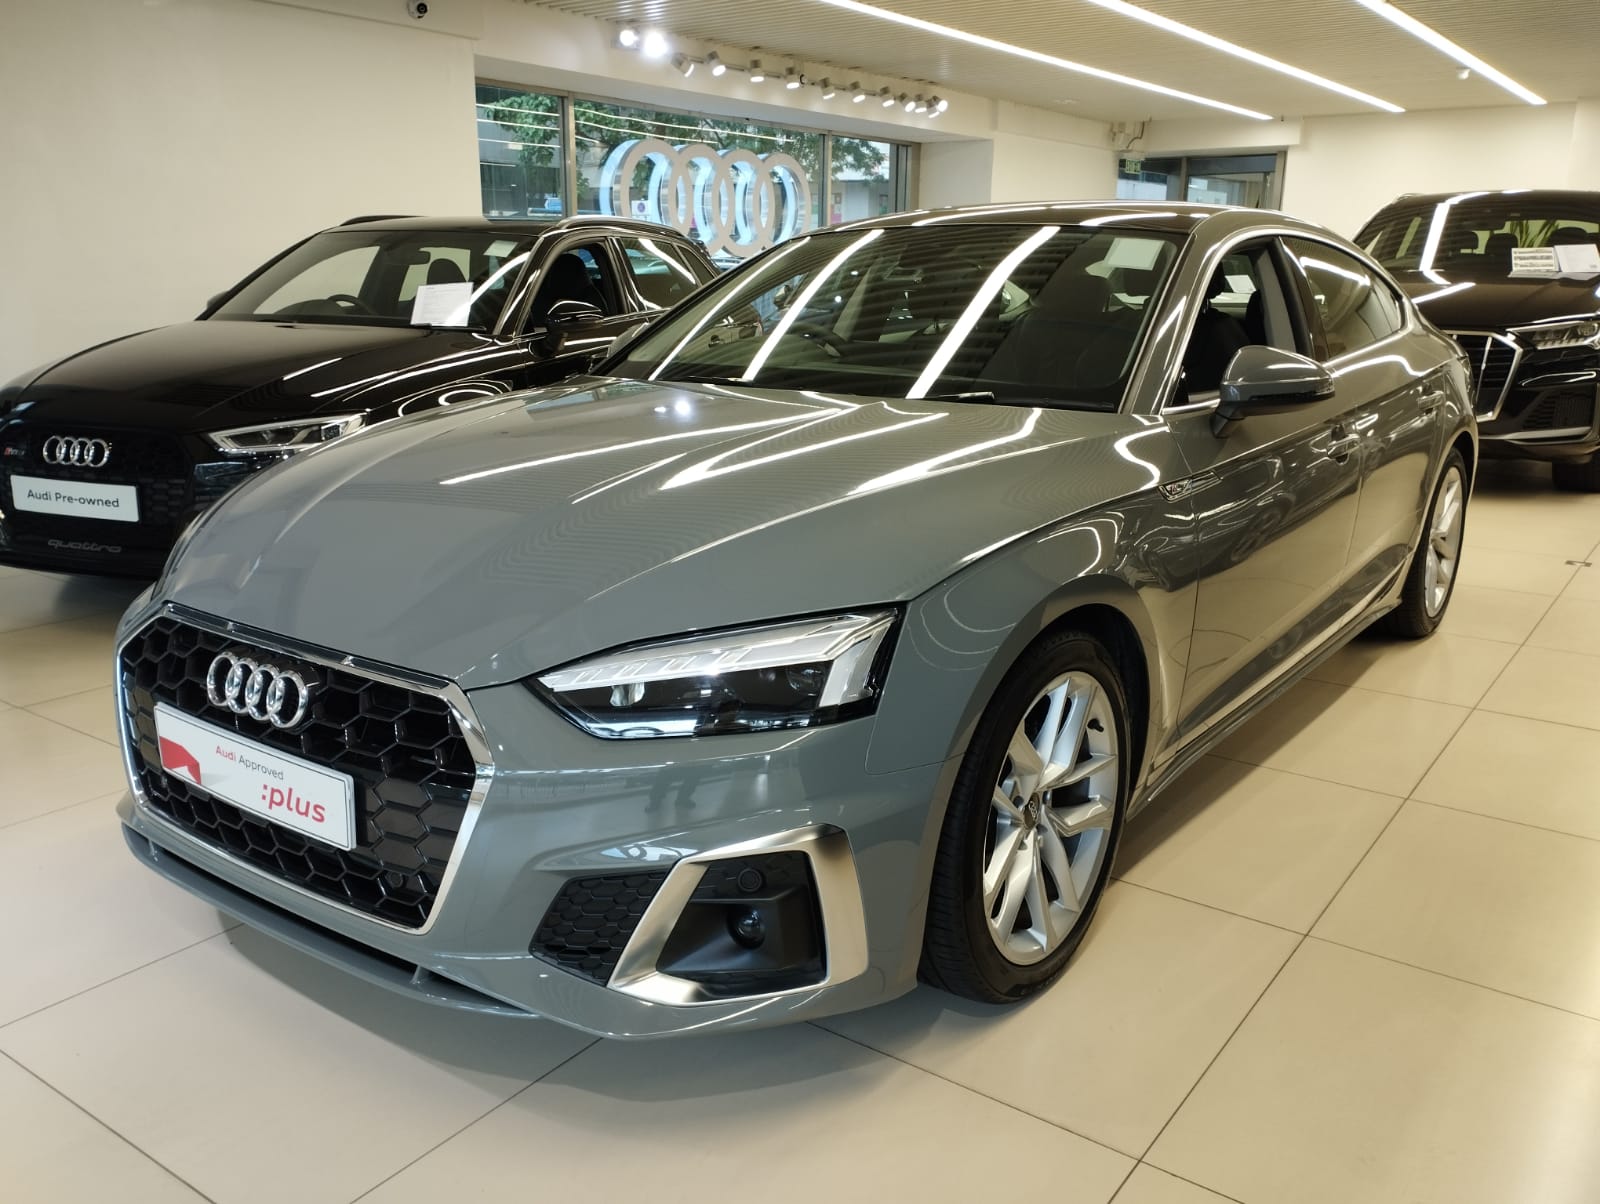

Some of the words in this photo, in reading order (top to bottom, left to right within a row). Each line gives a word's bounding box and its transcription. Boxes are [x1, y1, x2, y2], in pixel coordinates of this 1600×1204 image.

[27, 489, 52, 501] Audi
[55, 492, 120, 508] Pre-owned
[47, 539, 122, 553] quattro
[216, 745, 237, 762] Audi
[238, 755, 284, 780] Approved
[261, 784, 326, 823] :plus
